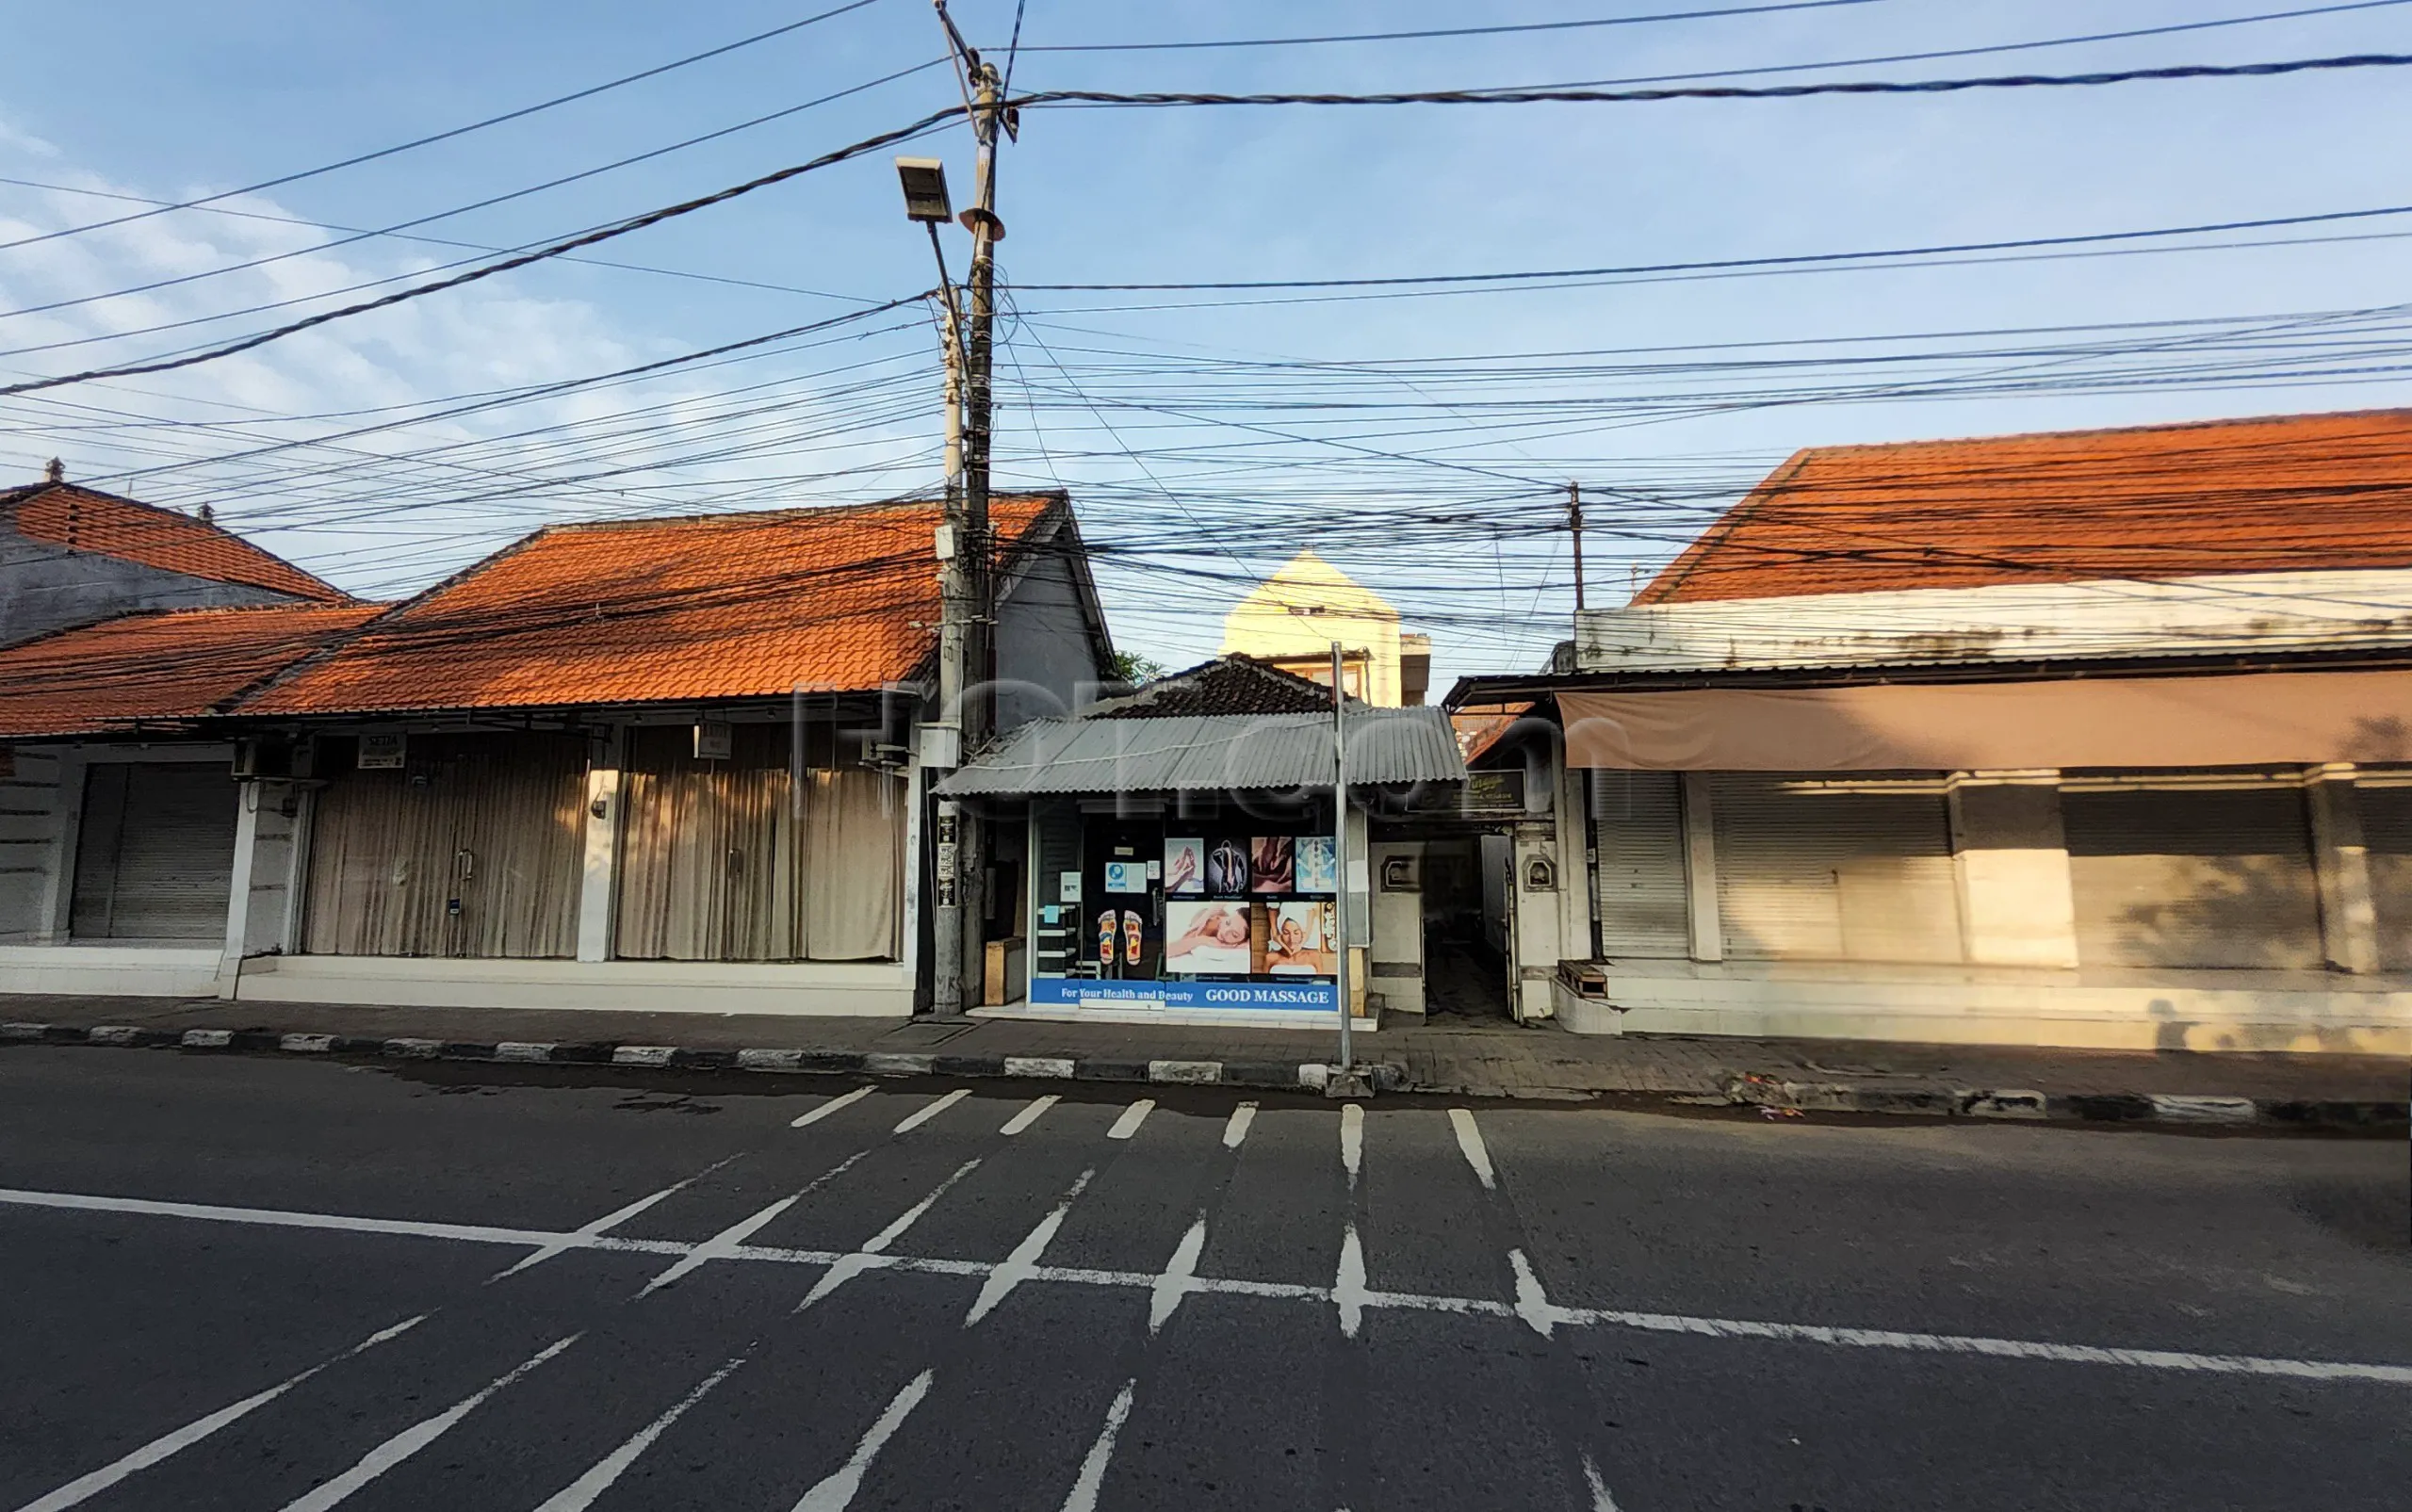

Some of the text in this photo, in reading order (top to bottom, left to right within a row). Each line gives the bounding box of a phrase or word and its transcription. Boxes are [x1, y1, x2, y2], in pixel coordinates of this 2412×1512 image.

[1061, 987, 1194, 1002] For Your Health and Beauty
[1205, 988, 1329, 1004] GOOD MASSAGE
